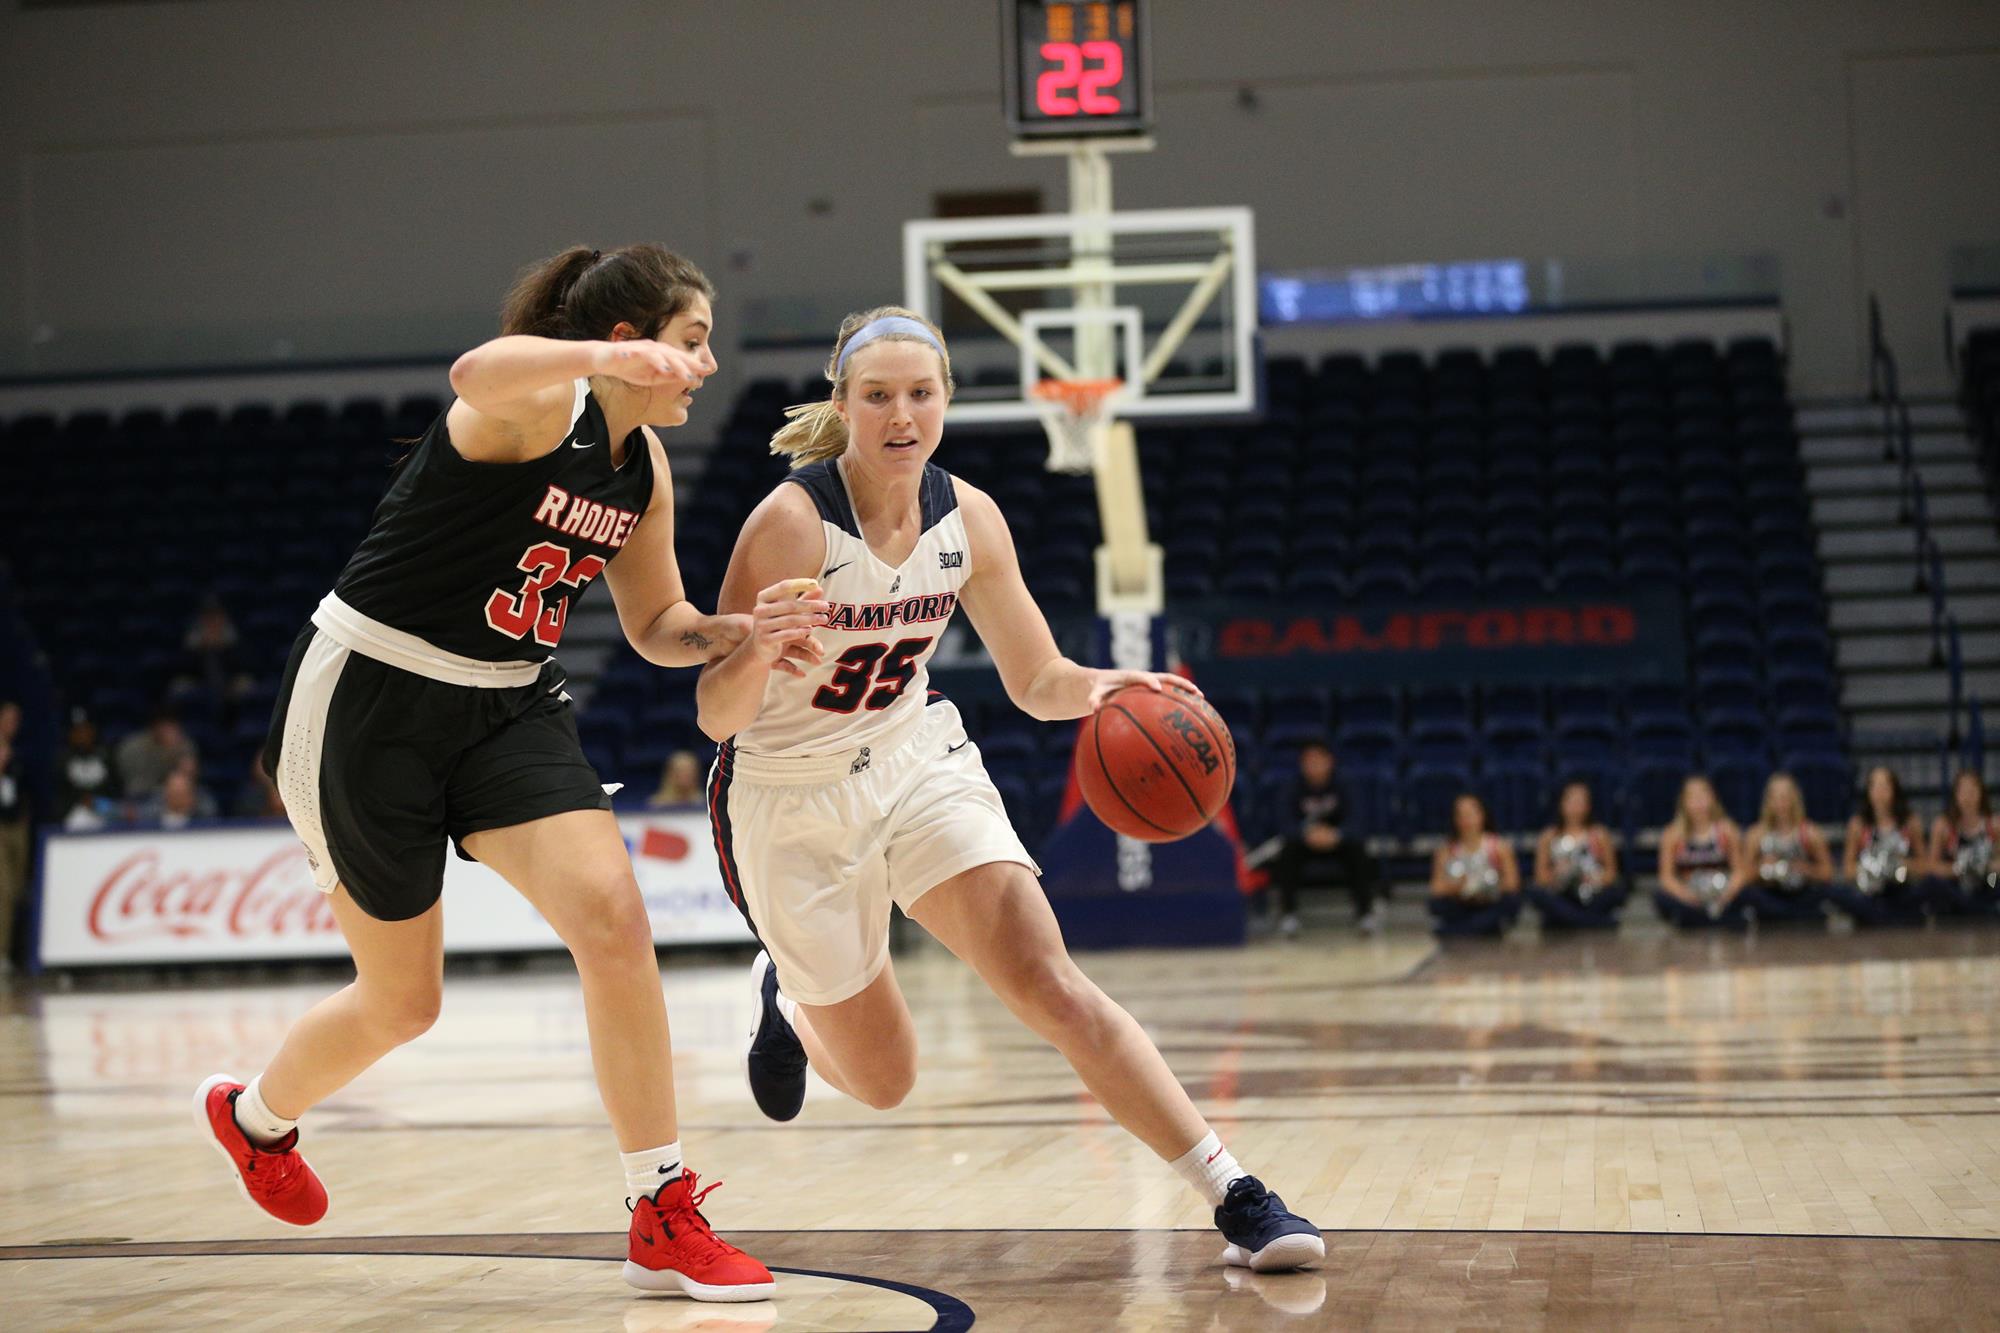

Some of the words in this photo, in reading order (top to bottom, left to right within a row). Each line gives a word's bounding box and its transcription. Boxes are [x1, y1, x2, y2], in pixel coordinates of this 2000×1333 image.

[1037, 41, 1124, 116] 22
[814, 592, 958, 631] AMFORD
[811, 636, 934, 714] 35
[1163, 708, 1219, 776] NCAA
